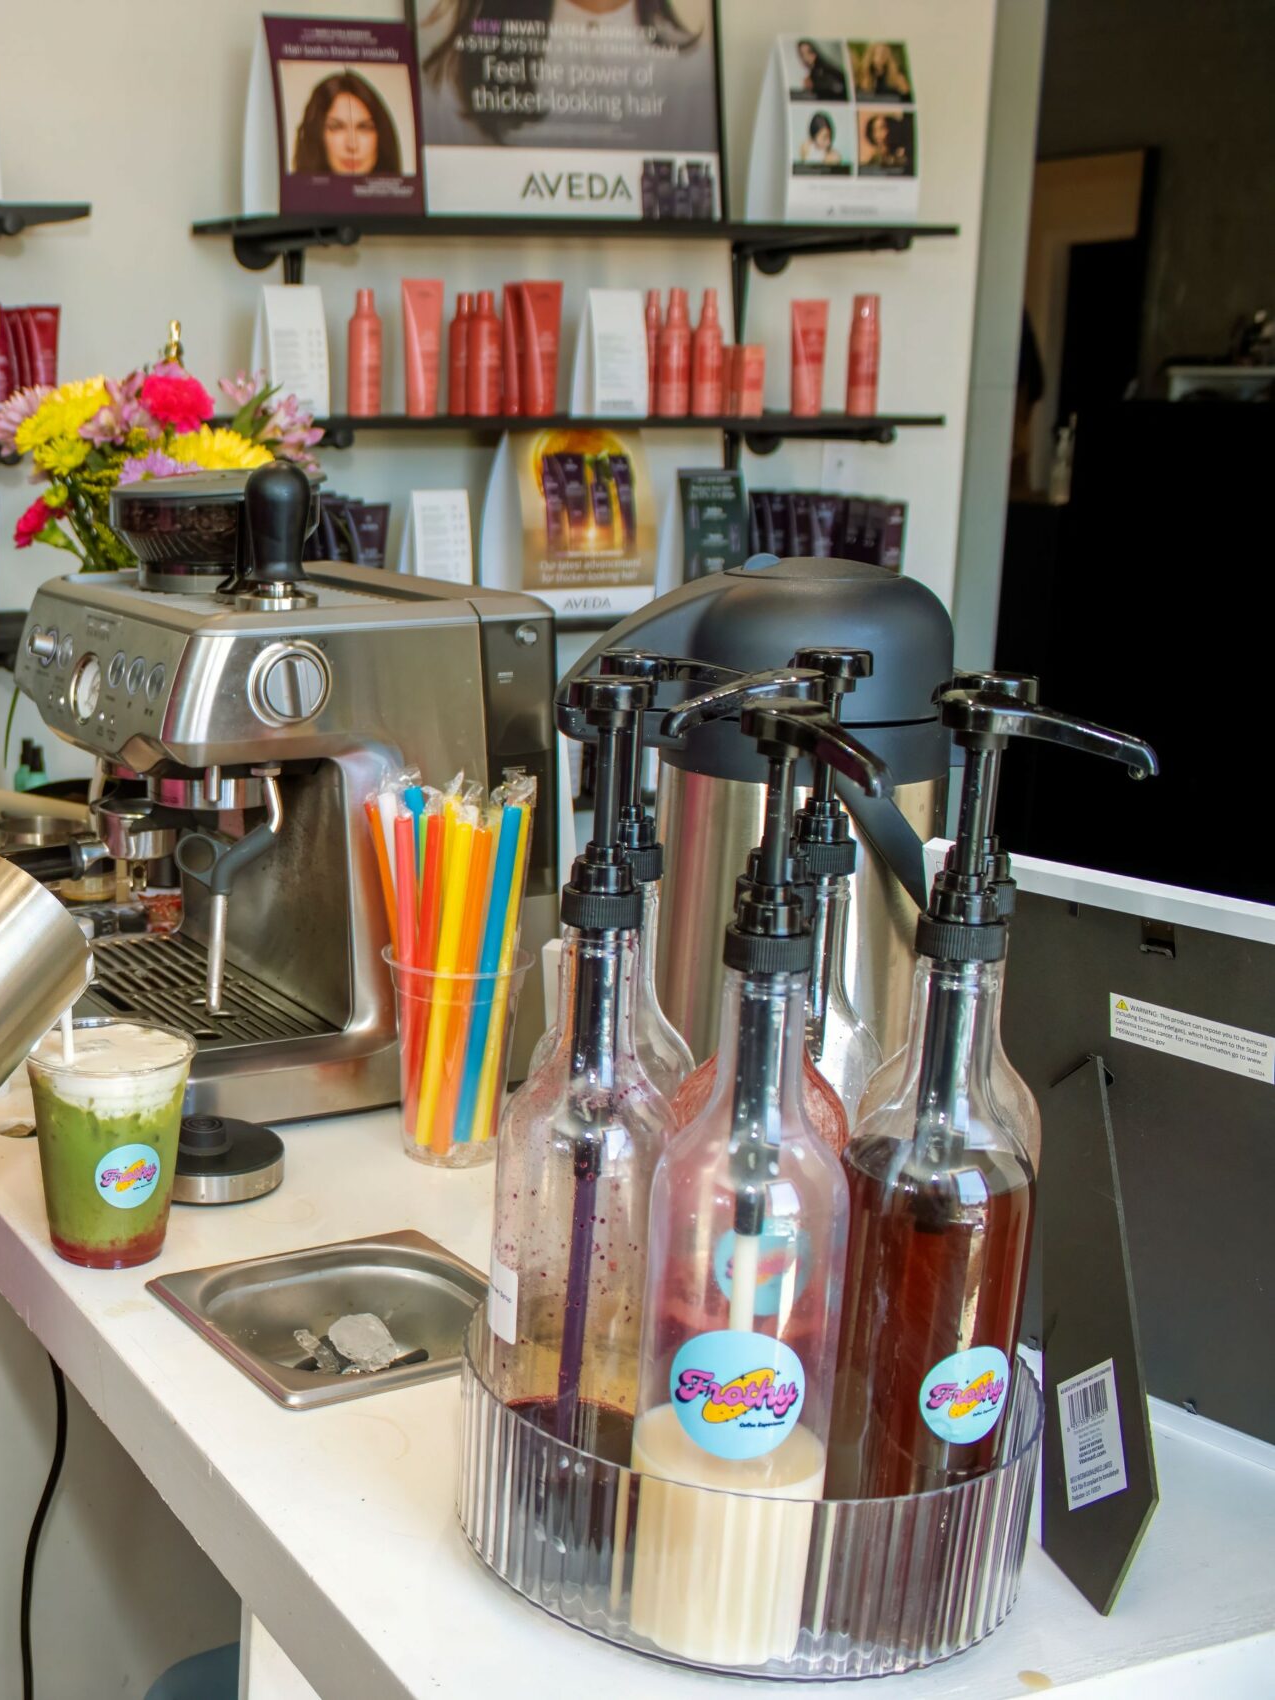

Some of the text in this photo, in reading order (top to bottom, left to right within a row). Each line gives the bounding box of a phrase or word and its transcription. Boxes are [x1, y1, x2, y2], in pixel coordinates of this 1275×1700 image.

[504, 20, 546, 35] INVATI
[484, 55, 654, 87] Feel the power of
[472, 85, 665, 121] thicker-looking hair
[522, 173, 632, 201] AVEDA
[563, 596, 611, 610] AVEDA
[1115, 1017, 1136, 1028] California
[1143, 1026, 1156, 1034] cause
[1184, 1038, 1198, 1046] more
[1199, 1042, 1230, 1054] information
[1160, 1012, 1170, 1021] This
[1170, 1016, 1190, 1027] product
[1202, 1026, 1221, 1036] expose
[1221, 1031, 1232, 1039] you
[1240, 1036, 1267, 1048] chemicals
[1187, 1029, 1203, 1039] which
[1209, 1035, 1227, 1046] known
[1246, 1046, 1259, 1055] State
[1261, 1049, 1267, 1057] of
[100, 1163, 157, 1187] Frothy
[675, 1369, 798, 1418] Frothy
[926, 1378, 1004, 1410] Frothy
